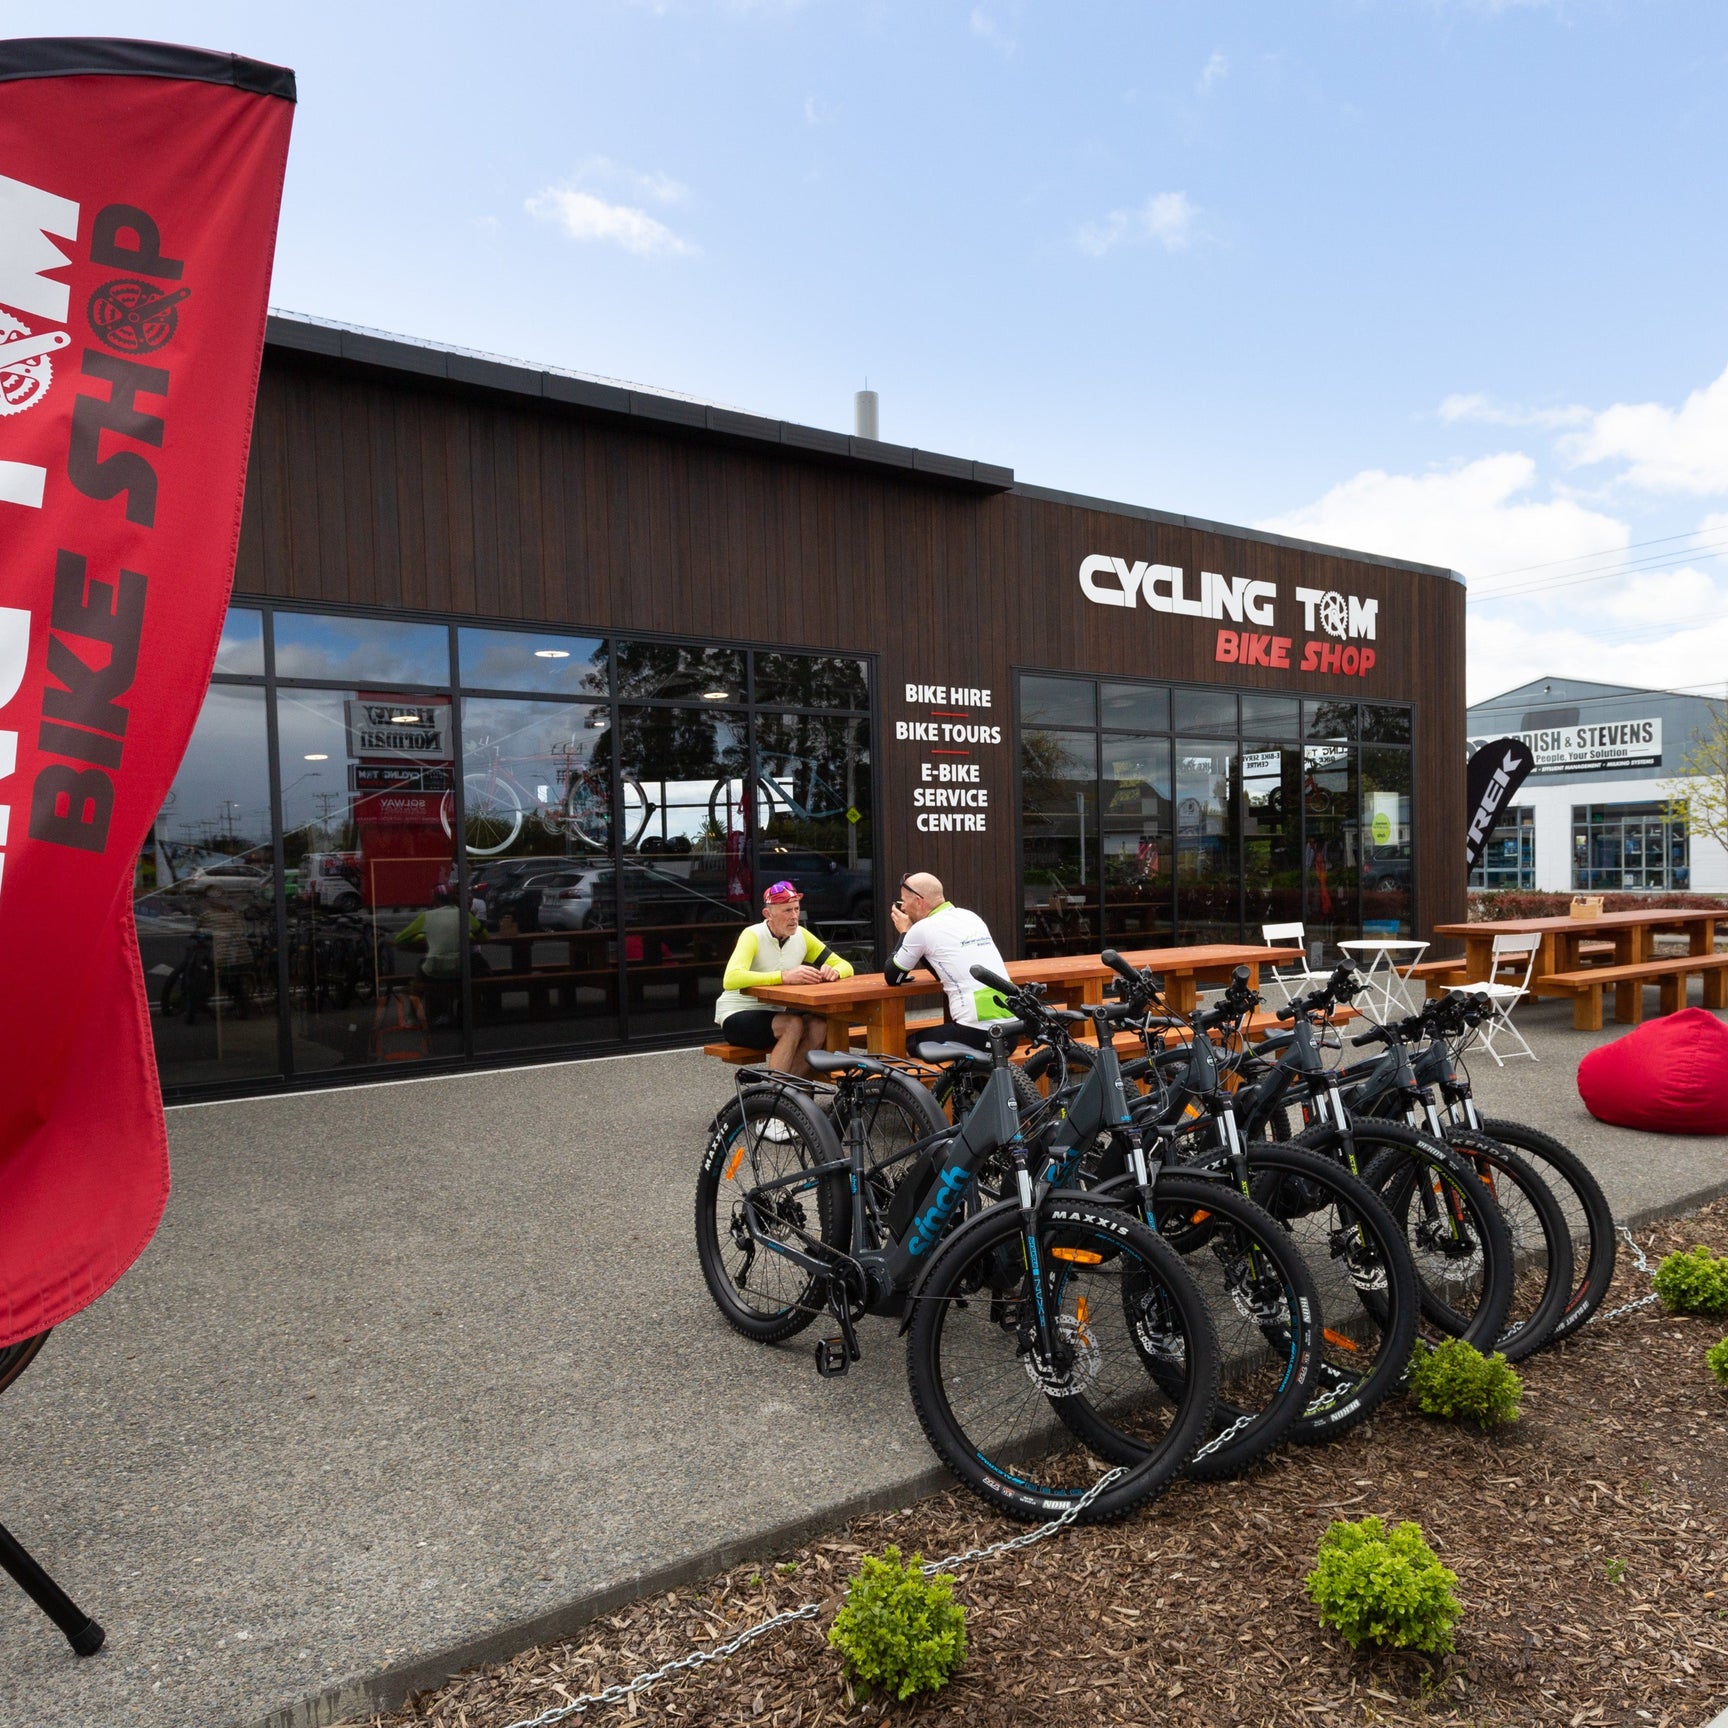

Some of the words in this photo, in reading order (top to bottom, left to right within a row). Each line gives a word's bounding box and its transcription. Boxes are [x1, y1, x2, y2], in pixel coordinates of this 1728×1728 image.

[67, 203, 191, 528] SHOP
[1079, 554, 1277, 627] CYCLING
[1296, 587, 1378, 640] TOM
[1215, 629, 1292, 669] BIKE
[1300, 641, 1376, 677] SHOP
[28, 548, 148, 854] BIKE
[905, 684, 947, 704] BIKE
[950, 687, 991, 707] HIRE
[896, 721, 939, 741] BIKE
[942, 724, 1001, 744] TOURS
[1565, 737, 1573, 748] &
[1576, 722, 1653, 749] STEVENS
[1568, 752, 1588, 761] Your
[1590, 749, 1628, 759] Solution
[921, 763, 980, 782] E-BIKE
[913, 788, 988, 807] SERVICE
[917, 814, 986, 832] CENTRE
[704, 1122, 729, 1171] MAXXIS
[1451, 1138, 1509, 1162] KENDA
[908, 1166, 971, 1256] sinch
[1052, 1210, 1130, 1236] MAXXIS
[1041, 1499, 1072, 1511] IKON
